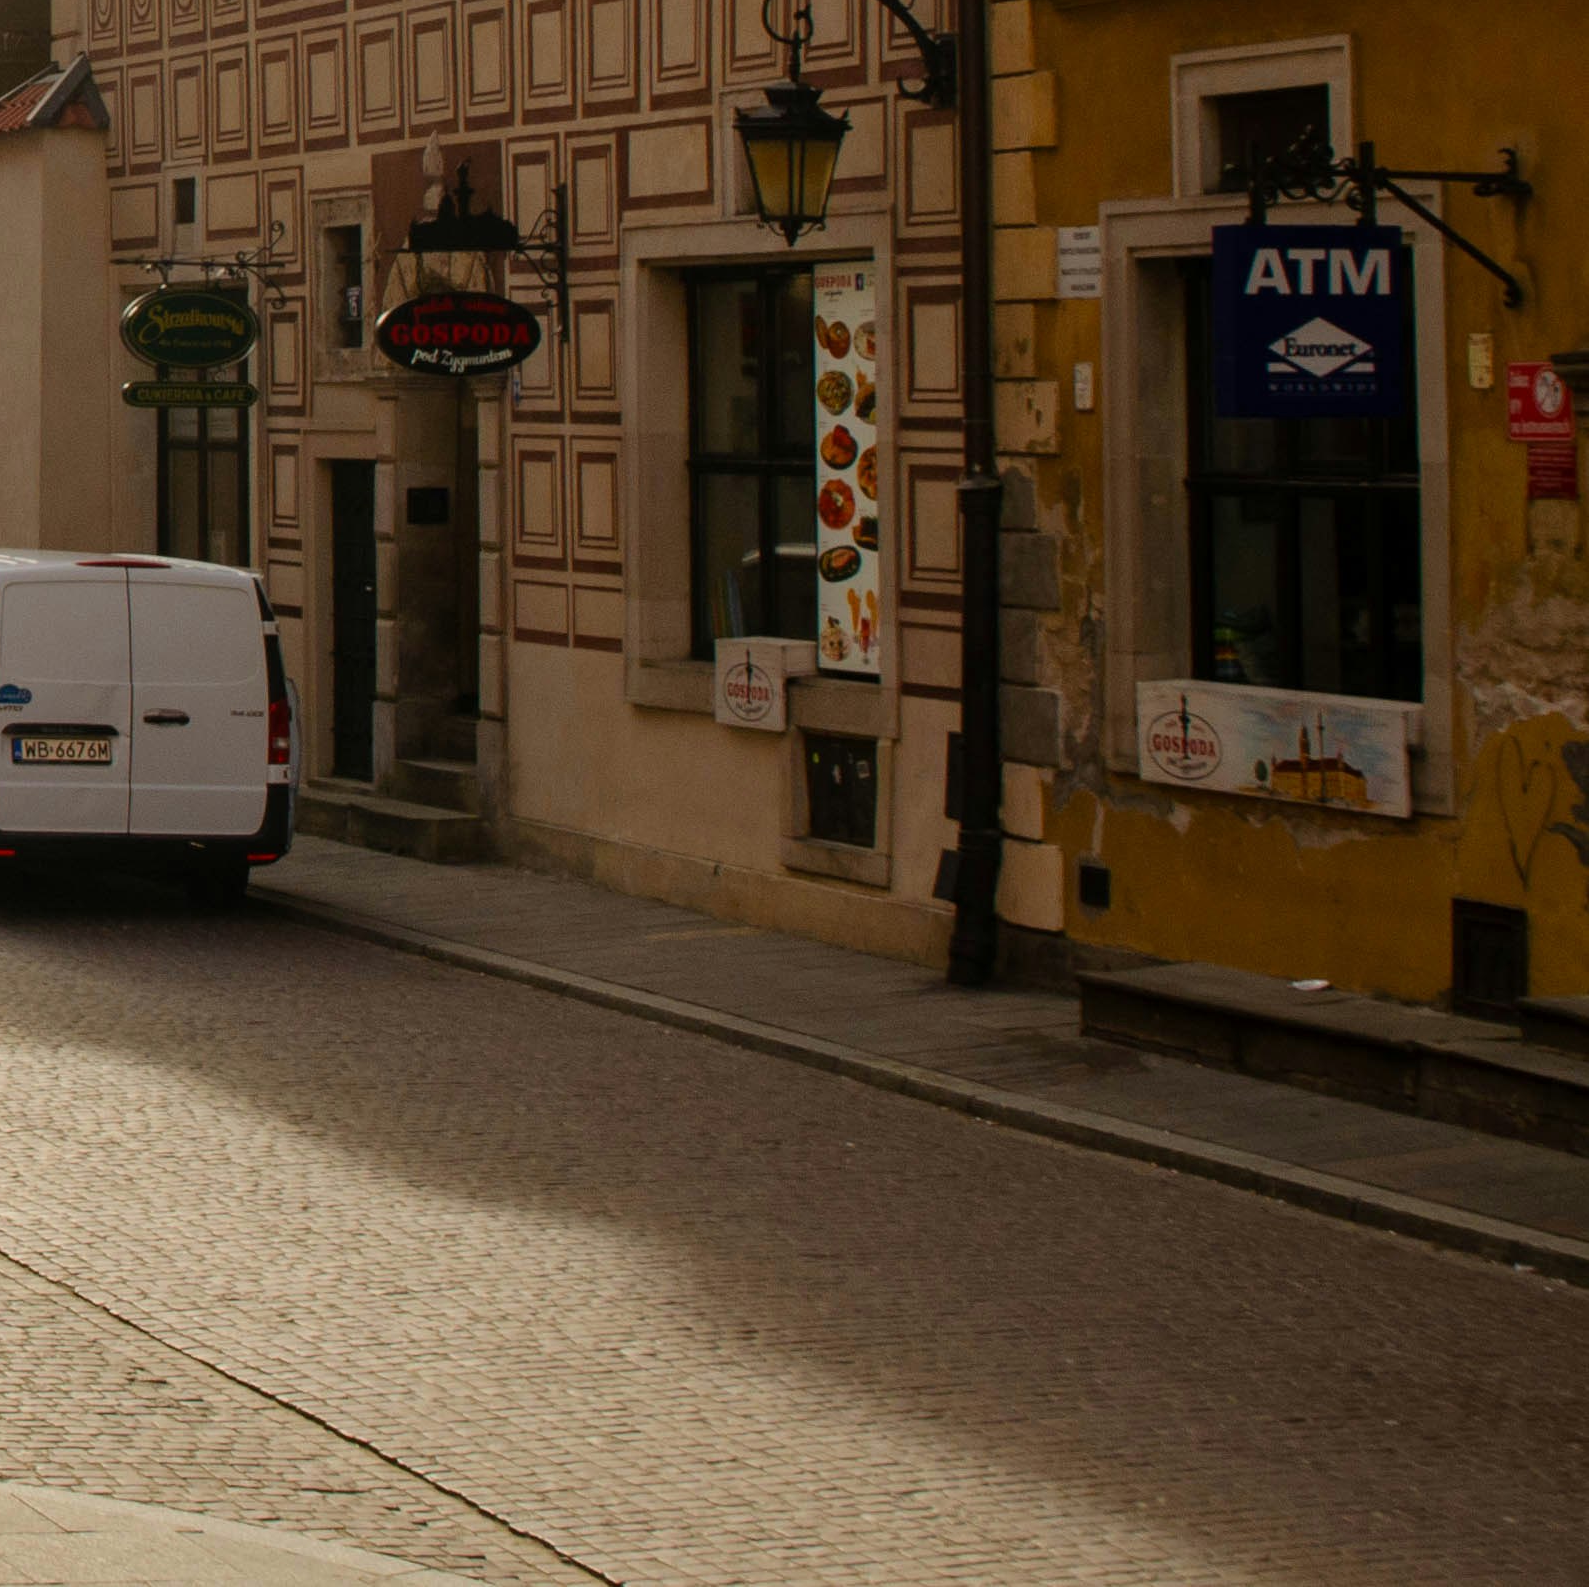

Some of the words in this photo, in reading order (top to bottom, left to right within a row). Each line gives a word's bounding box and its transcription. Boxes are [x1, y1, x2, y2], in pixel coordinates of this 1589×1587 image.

[1243, 247, 1392, 296] ATM
[390, 323, 531, 346] GOSPODA
[1284, 338, 1357, 357] Euronet
[410, 348, 439, 364] pod
[441, 348, 514, 373] Zygmuntem
[25, 741, 49, 758] WB
[56, 742, 108, 758] 6676M
[1152, 733, 1217, 756] GOSPODA
